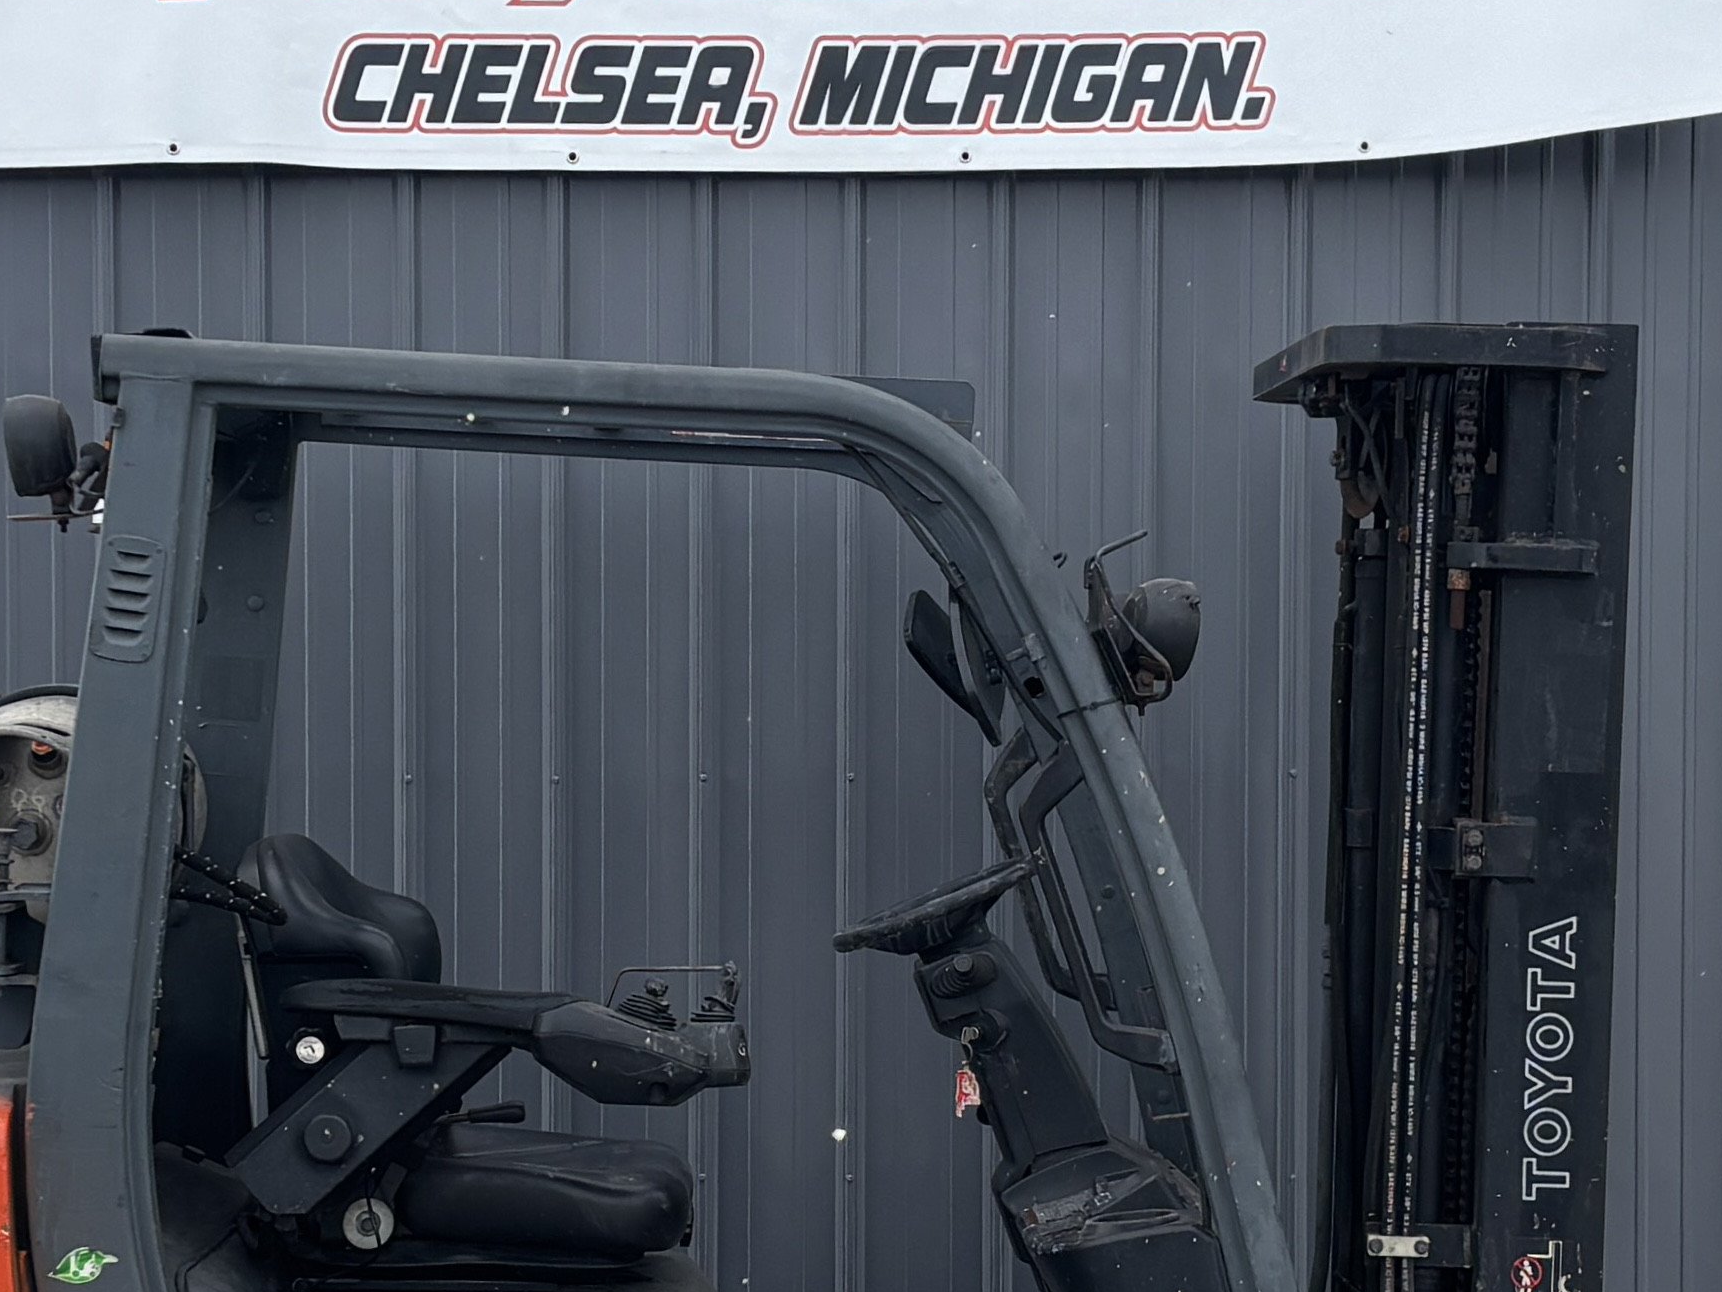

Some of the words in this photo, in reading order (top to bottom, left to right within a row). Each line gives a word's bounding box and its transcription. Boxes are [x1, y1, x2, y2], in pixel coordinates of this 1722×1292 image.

[325, 34, 768, 148] CHELSEA,
[791, 33, 1270, 136] MICHIGAN.
[1521, 916, 1578, 1201] TOYOTA
